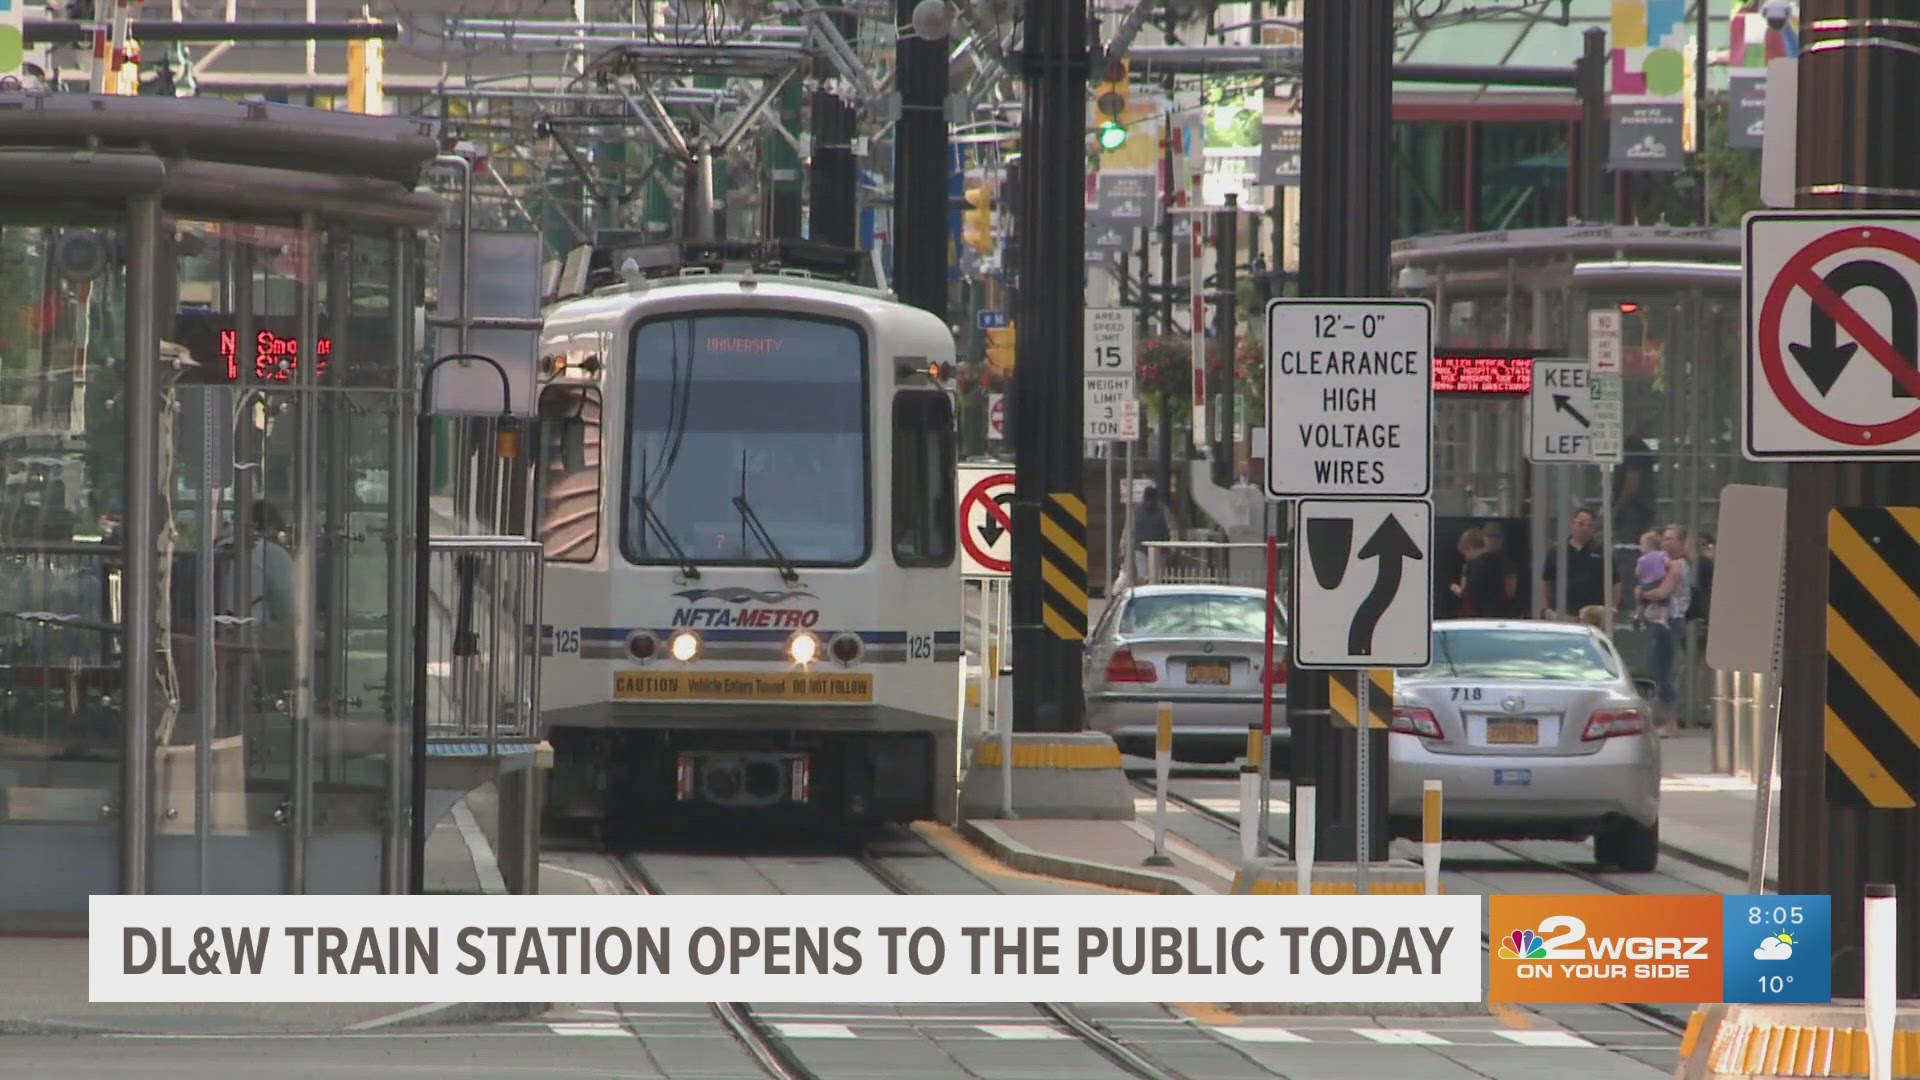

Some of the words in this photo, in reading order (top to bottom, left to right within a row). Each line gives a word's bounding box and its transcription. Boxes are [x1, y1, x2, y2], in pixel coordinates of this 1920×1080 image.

[1096, 312, 1121, 320] AREA
[1093, 323, 1125, 332] SPEED
[706, 337, 784, 352] UNIVERSITY
[1095, 333, 1120, 341] LIMIT
[1095, 346, 1122, 367] 15
[1281, 351, 1418, 375] CLEARANCE
[1087, 380, 1129, 390] WEIGHT
[1093, 393, 1122, 404] LIMIT
[1323, 387, 1376, 412] HIGH
[1104, 406, 1113, 420] 3
[1299, 425, 1401, 448] VOLTAGE
[1314, 461, 1385, 485] WIRES
[672, 608, 820, 628] NFTA-METRO
[555, 630, 579, 653] 125
[909, 636, 931, 659] 125
[616, 677, 679, 693] CAUTION
[792, 680, 806, 695] DO
[808, 680, 827, 694] NOT
[830, 680, 868, 695] FOLLOW
[1451, 687, 1482, 701] 718
